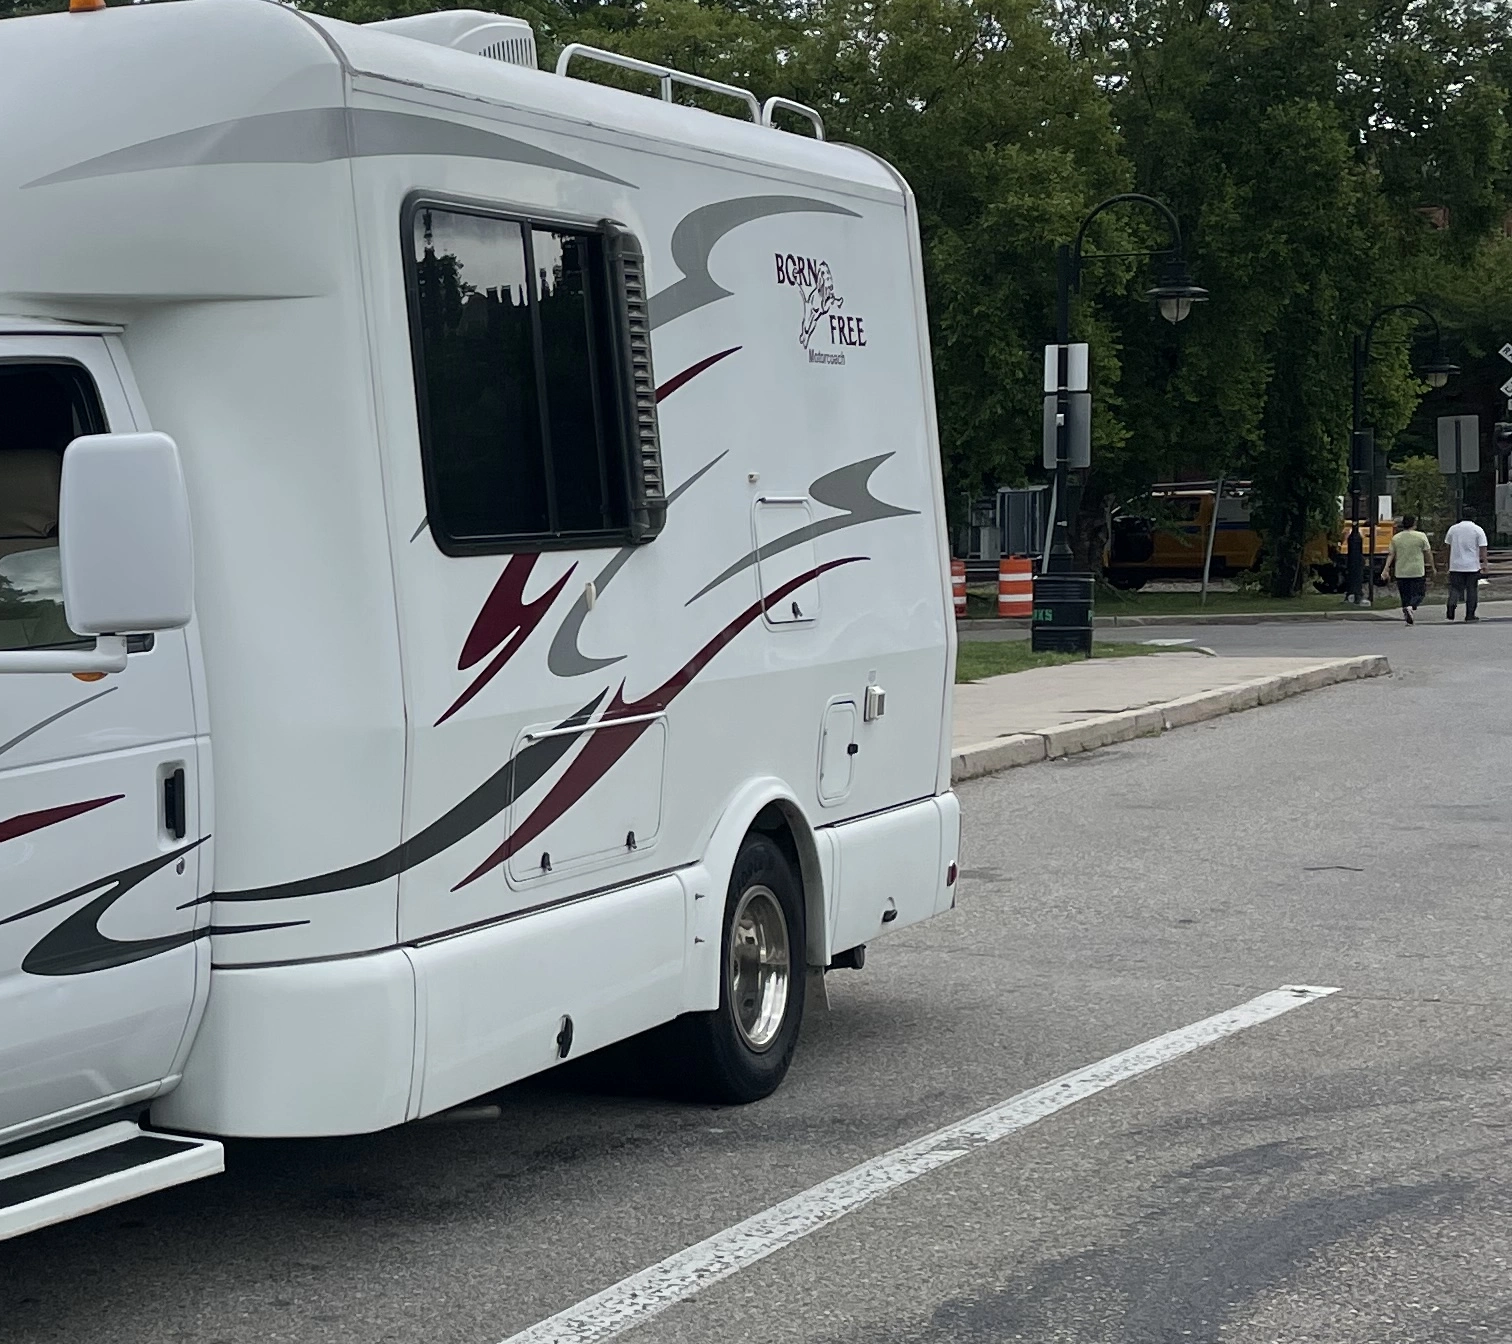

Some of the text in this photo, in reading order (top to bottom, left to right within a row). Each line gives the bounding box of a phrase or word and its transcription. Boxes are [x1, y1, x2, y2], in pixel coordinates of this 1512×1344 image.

[774, 253, 820, 288] BORN
[828, 313, 868, 347] FREE
[808, 348, 846, 366] Motorcoach
